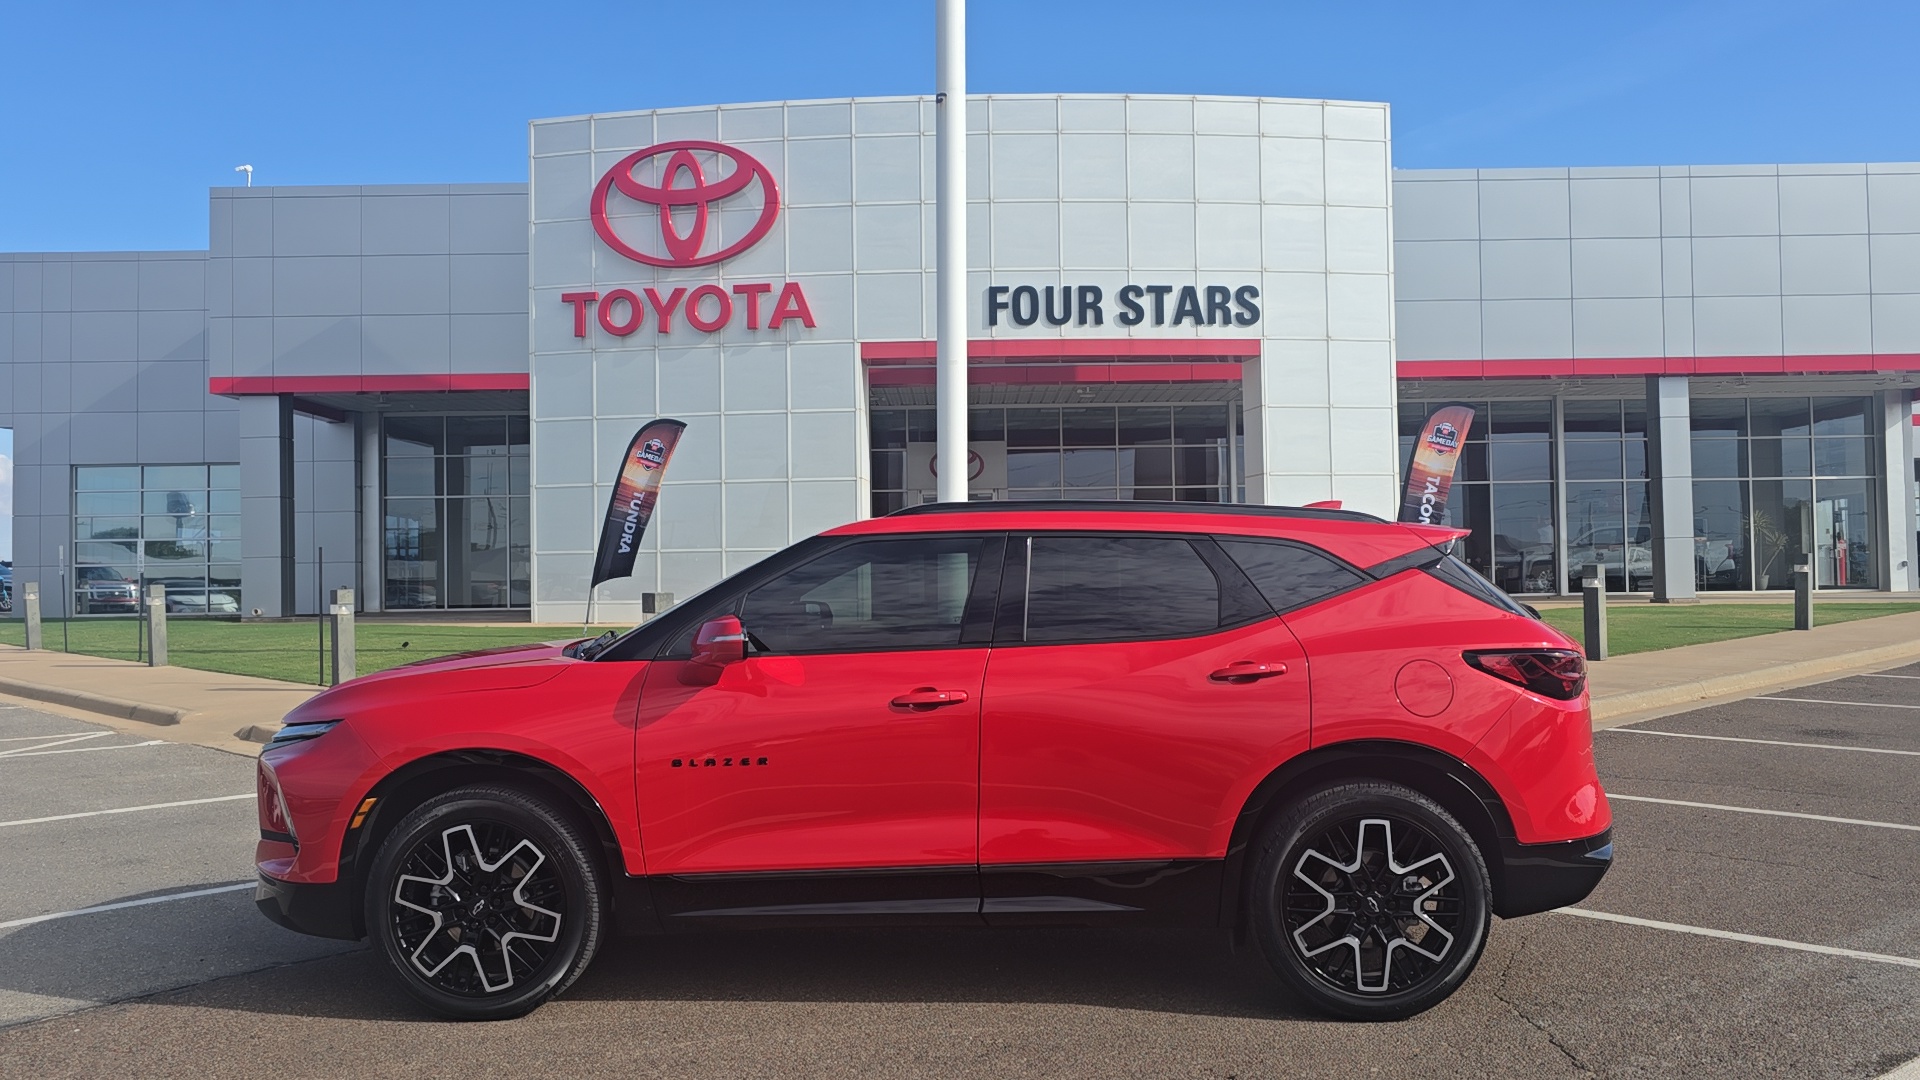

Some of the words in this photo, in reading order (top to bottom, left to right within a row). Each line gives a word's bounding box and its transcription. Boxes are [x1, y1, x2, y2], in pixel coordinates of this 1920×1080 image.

[561, 282, 817, 337] TOYOTA
[988, 285, 1104, 326] FOUR
[1119, 285, 1261, 326] STARS
[1427, 434, 1459, 448] GAMEDAY
[618, 491, 645, 554] TUNDRA
[670, 756, 769, 768] BLAZER
